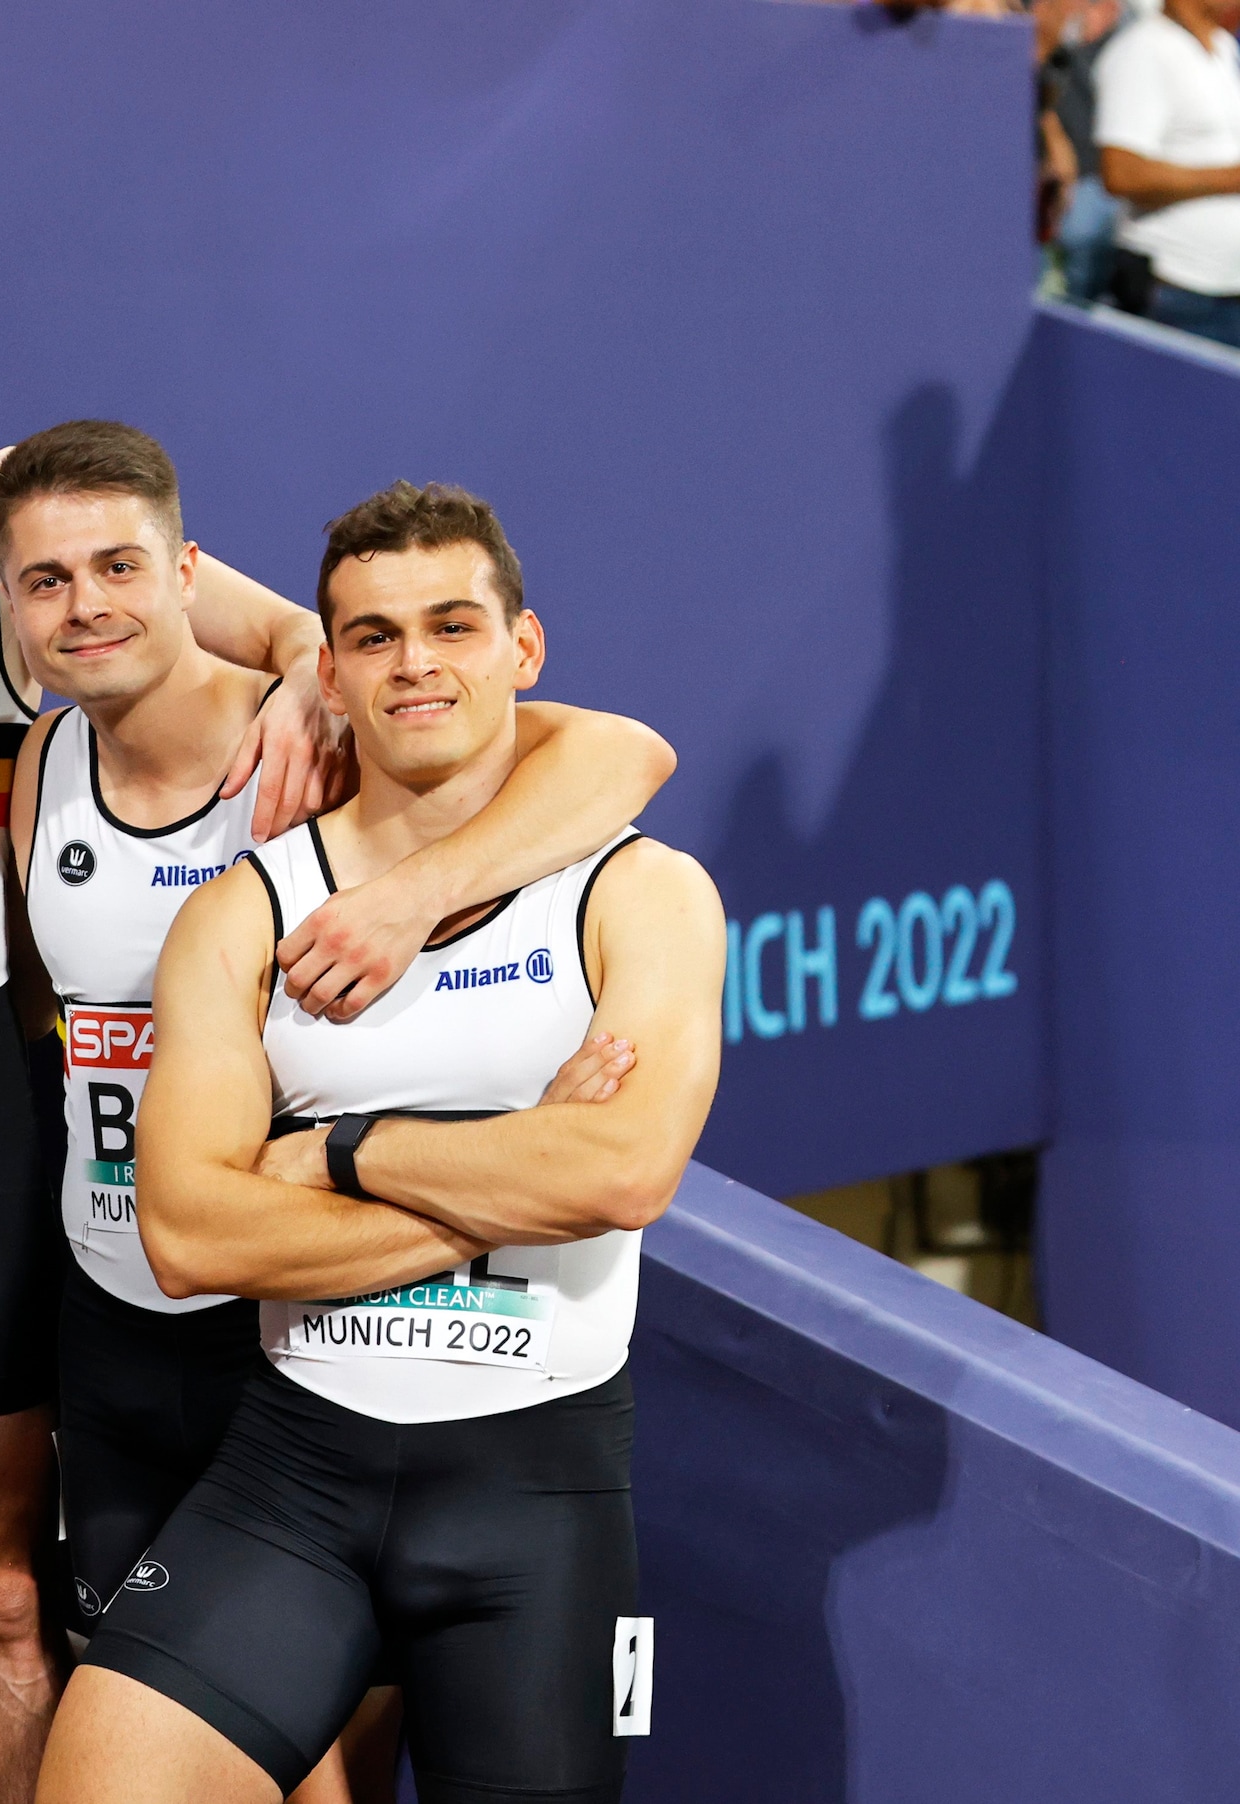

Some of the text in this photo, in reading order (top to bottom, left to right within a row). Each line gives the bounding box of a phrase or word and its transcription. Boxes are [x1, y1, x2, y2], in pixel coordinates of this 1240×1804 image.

[61, 865, 89, 879] vermarc
[151, 863, 226, 886] Allianz
[856, 879, 1018, 1021] 2022
[434, 961, 521, 992] Allianz
[72, 1018, 155, 1061] SPA
[91, 1190, 137, 1223] MUN
[302, 1314, 531, 1358] MUNICH 2022
